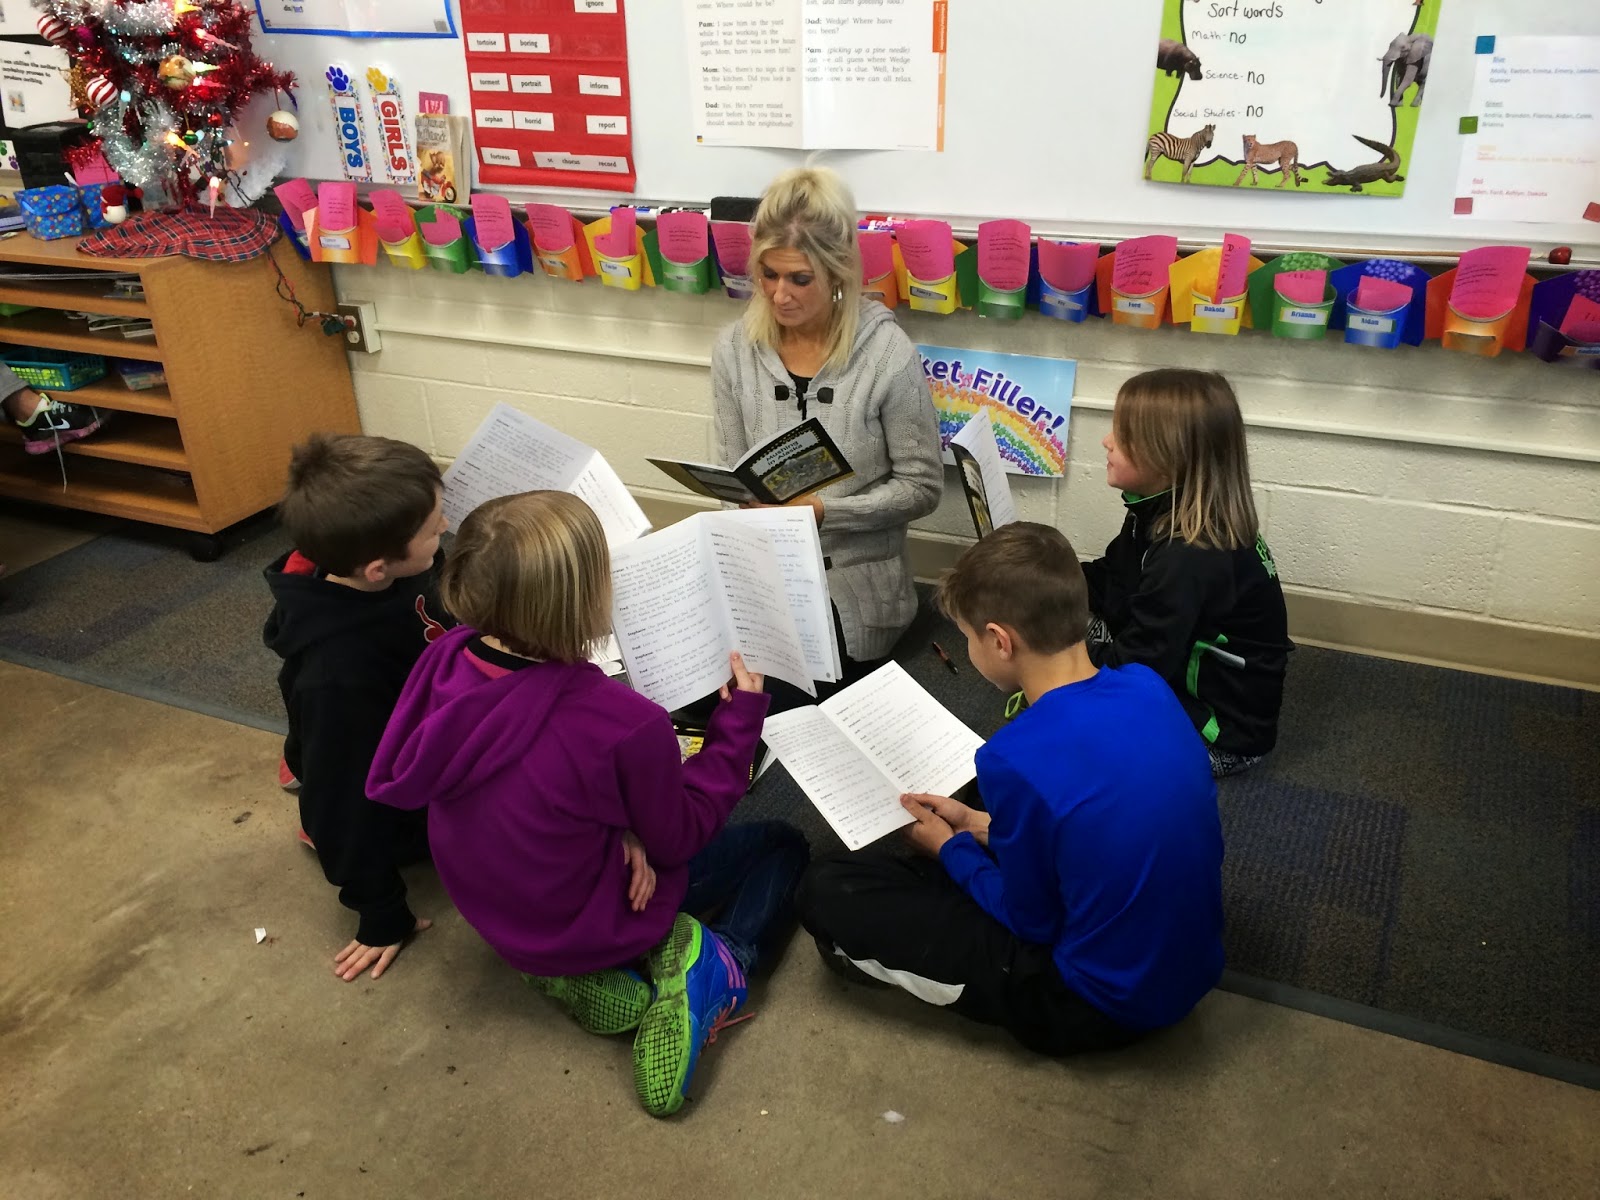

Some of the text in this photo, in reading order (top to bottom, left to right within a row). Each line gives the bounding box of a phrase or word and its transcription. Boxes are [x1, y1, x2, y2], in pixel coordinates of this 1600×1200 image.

[1208, 0, 1283, 18] Sort words
[520, 40, 538, 48] boring
[1230, 32, 1246, 44] no
[890, 56, 910, 64] Wedge
[1247, 70, 1265, 85] no
[521, 80, 541, 88] portrait
[590, 82, 609, 90] inform
[1173, 109, 1197, 118] Social
[1246, 105, 1264, 118] no
[485, 116, 503, 124] orphan
[339, 107, 363, 168] BOYS
[380, 100, 407, 171] GIRLS
[490, 153, 510, 161] fortress
[919, 354, 1066, 436] ket Filler!
[766, 441, 799, 461] Mushing
[778, 444, 803, 460] Alaska
